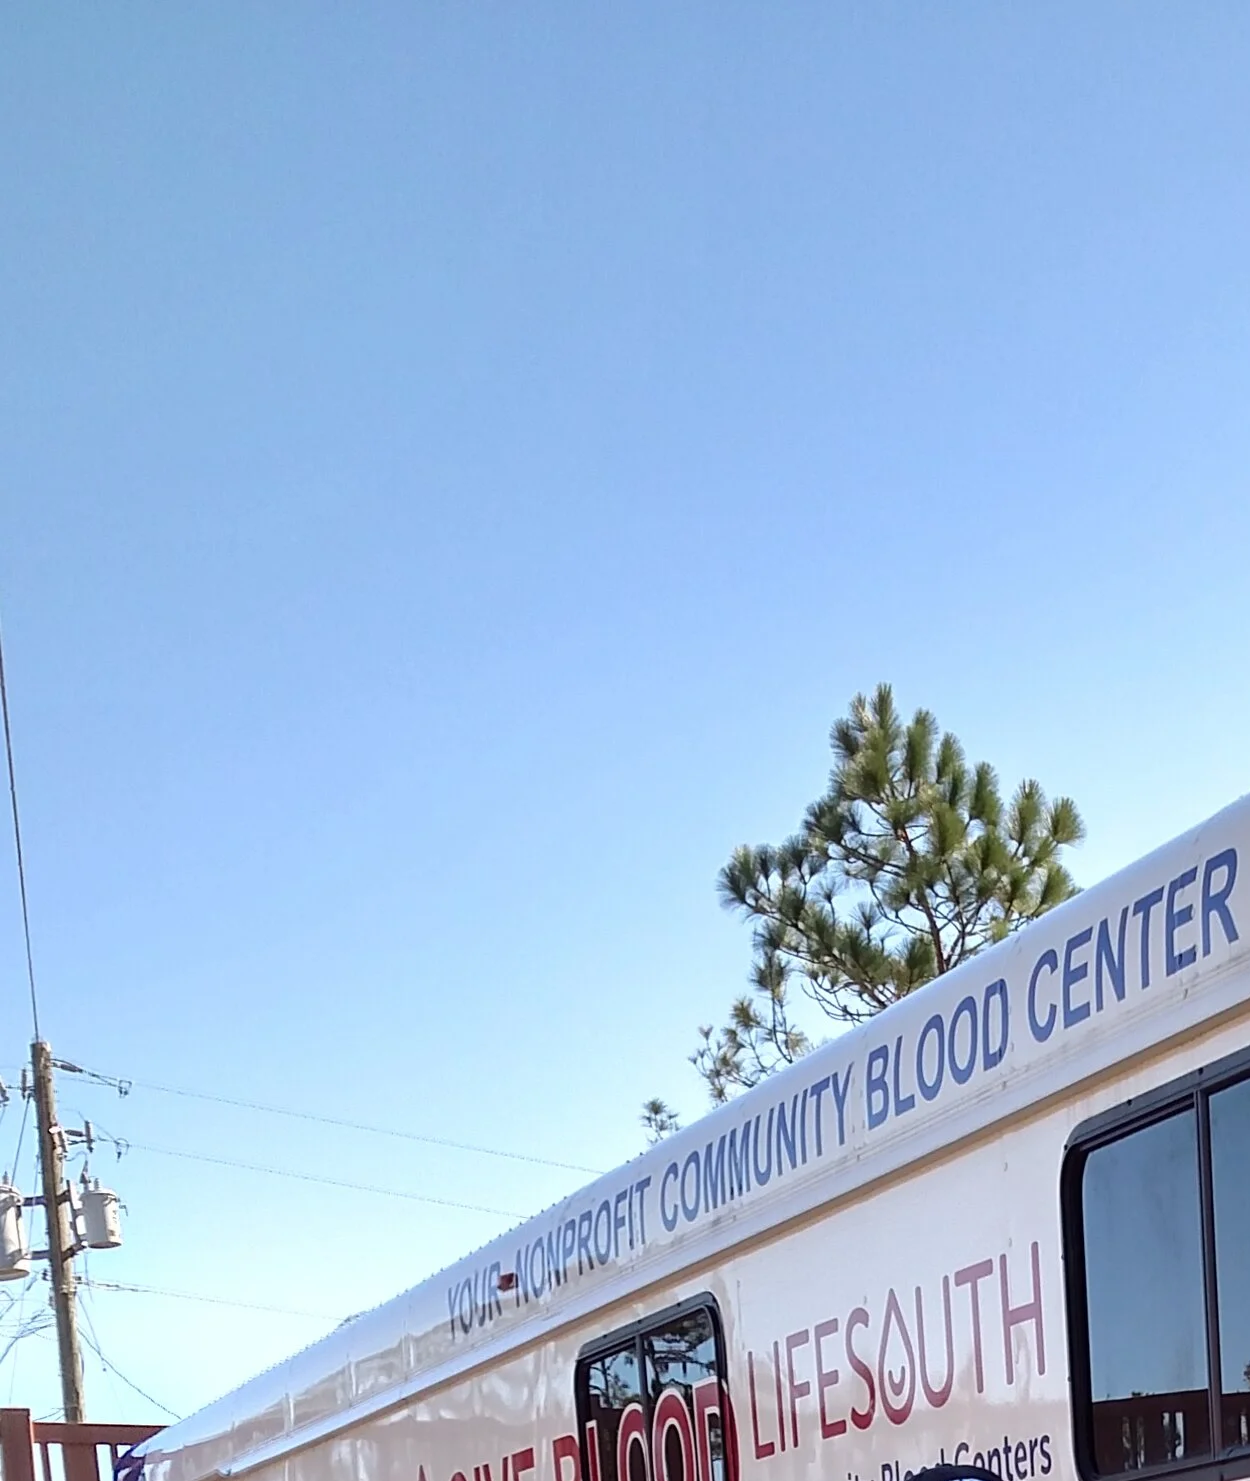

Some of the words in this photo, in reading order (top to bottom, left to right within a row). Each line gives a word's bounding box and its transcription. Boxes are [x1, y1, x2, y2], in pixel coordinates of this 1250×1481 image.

[447, 1261, 502, 1340] YOUR
[514, 1175, 652, 1308] NONPROFIT
[660, 1061, 854, 1233] COMMUNITY
[866, 977, 1009, 1131] BLOOD
[1028, 847, 1240, 1043] CENTER
